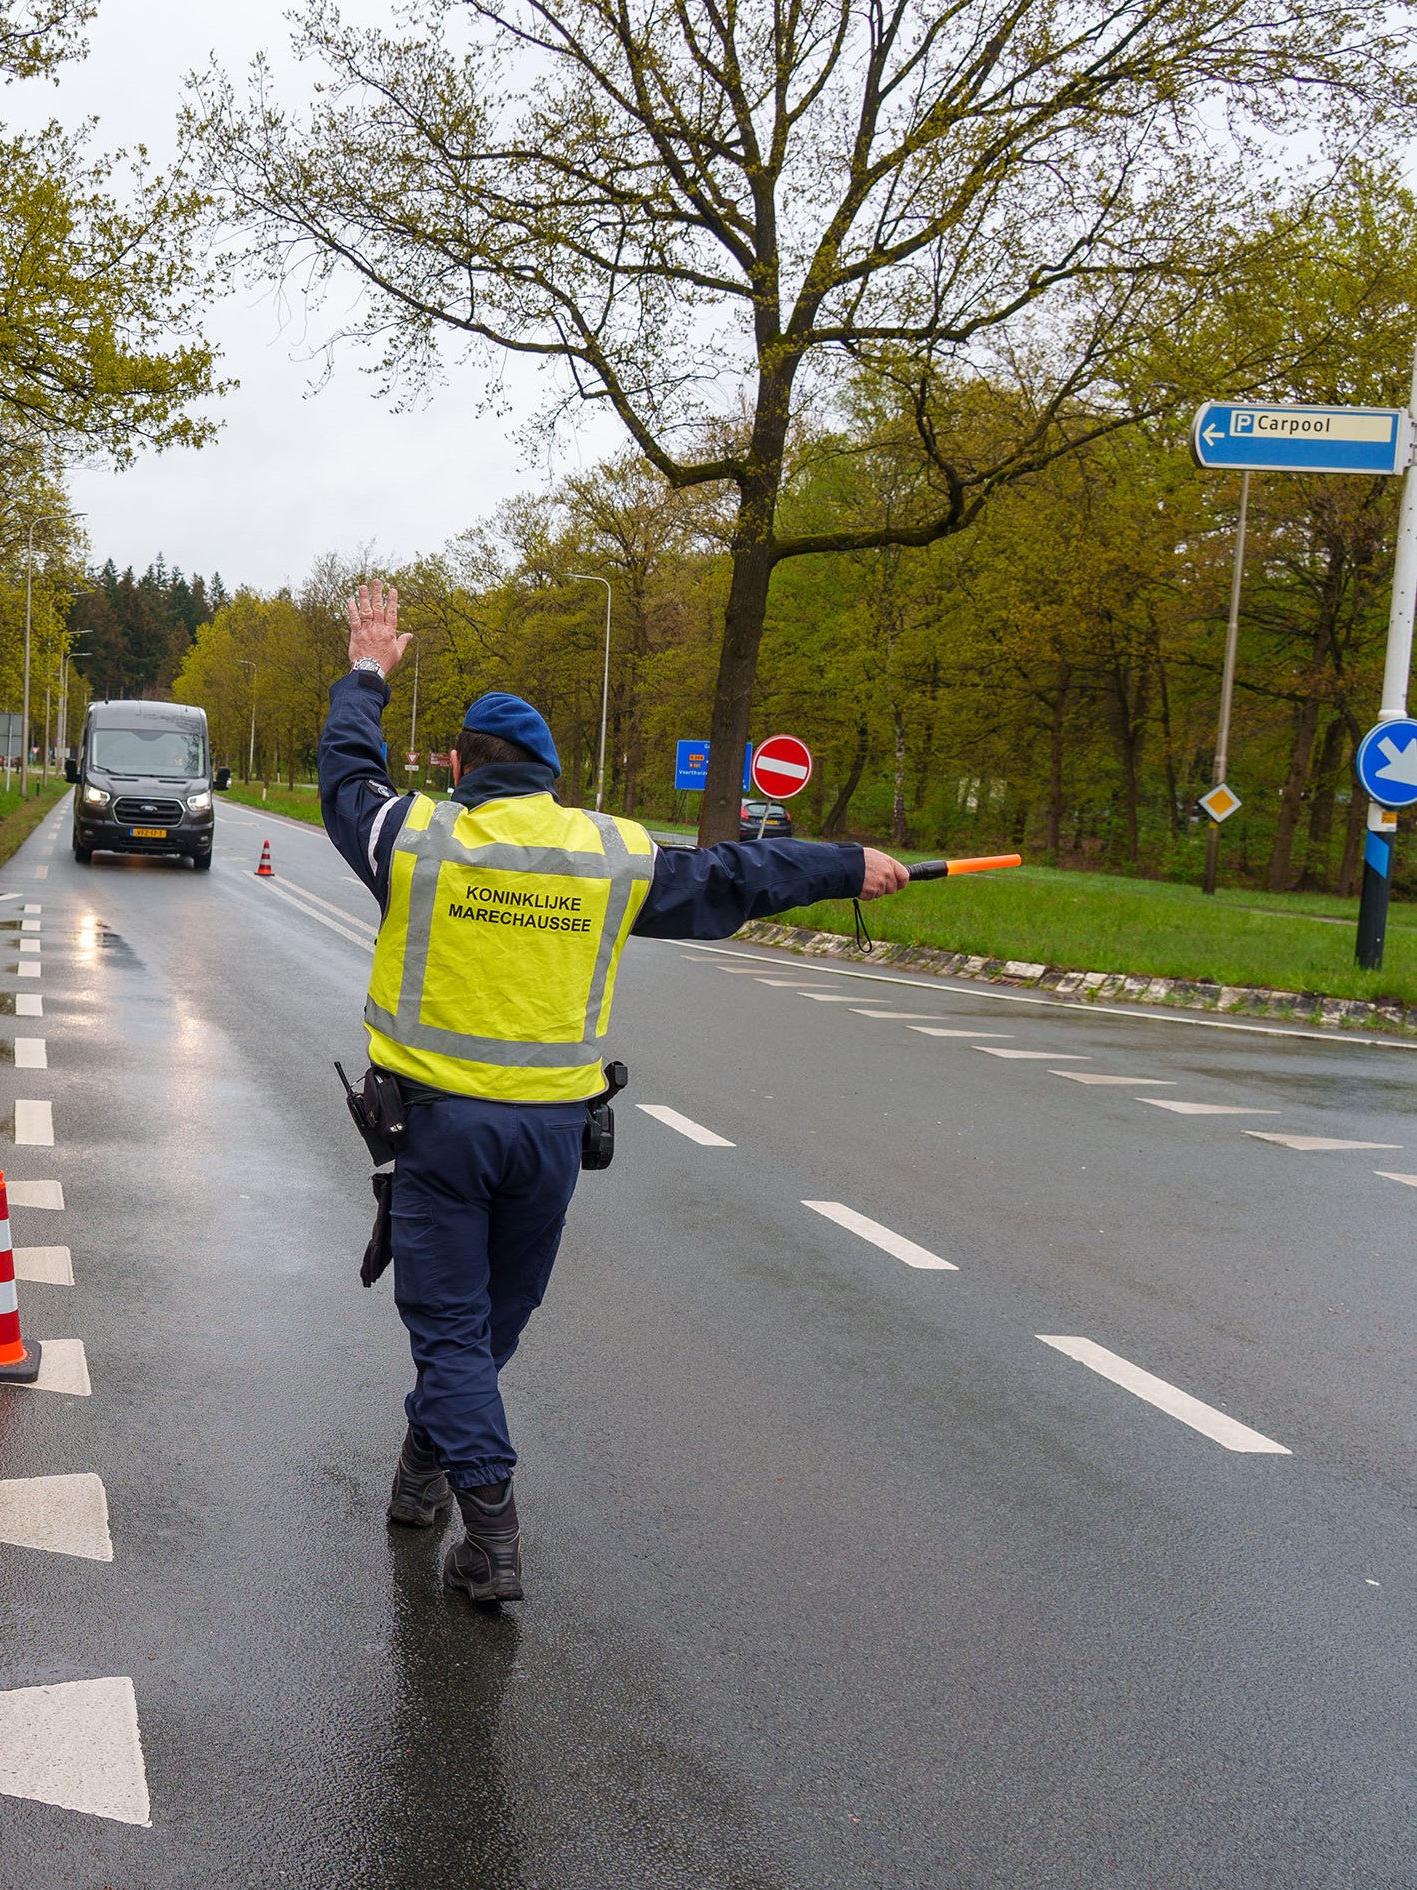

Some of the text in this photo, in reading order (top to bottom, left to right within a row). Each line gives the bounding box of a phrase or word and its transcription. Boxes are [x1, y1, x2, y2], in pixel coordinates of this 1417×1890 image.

[1258, 415, 1331, 435] Carpool
[466, 885, 582, 912] KONINKLIJKE
[448, 904, 592, 932] MARECHAUSSEE
